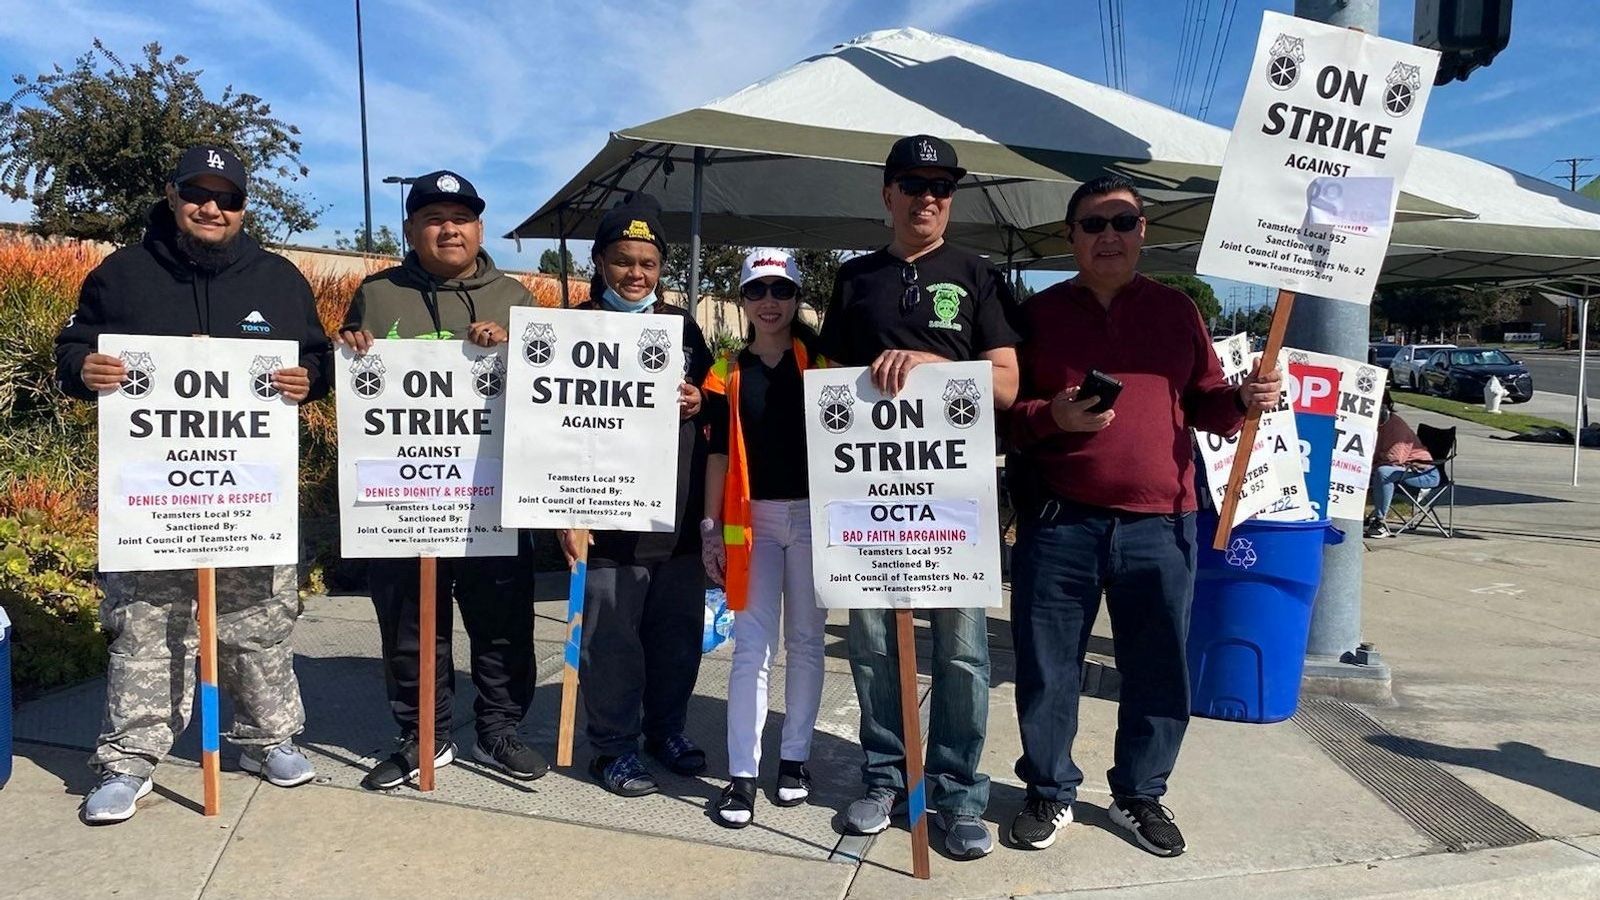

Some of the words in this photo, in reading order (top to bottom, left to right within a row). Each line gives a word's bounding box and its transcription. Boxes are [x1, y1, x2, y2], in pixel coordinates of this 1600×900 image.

[1316, 65, 1368, 106] ON
[1261, 102, 1393, 159] STRIKE
[206, 150, 225, 170] LA
[1285, 154, 1350, 178] AGAINST
[1257, 219, 1301, 234] Teamsters
[1303, 228, 1326, 241] Local
[1328, 232, 1346, 244] 952
[1265, 235, 1313, 252] Sanctioned
[1316, 246, 1330, 256] By:
[1220, 240, 1242, 252] Joint
[1244, 245, 1278, 259] Council
[1281, 252, 1291, 262] of
[1293, 253, 1335, 271] Teamsters
[1337, 261, 1352, 272] No.
[1354, 265, 1365, 276] 42
[1248, 259, 1333, 282] www.Teamsters952.org
[241, 324, 271, 333] TOKYO
[572, 341, 619, 369] ON
[174, 370, 229, 399] ON
[403, 370, 452, 398] ON
[532, 377, 655, 408] STRIKE
[872, 399, 924, 430] ON
[130, 409, 270, 438] STRIKE
[365, 408, 492, 435] STRIKE
[562, 416, 624, 429] AGAINST
[166, 450, 237, 462] AGAINST
[397, 446, 461, 458] AGAINST
[835, 439, 967, 473] STRIKE
[399, 464, 461, 480] OCTA
[1332, 459, 1362, 473] GAINING
[168, 470, 236, 486] OCTA
[548, 474, 590, 482] Teamsters
[366, 488, 399, 497] DENIES
[404, 487, 441, 497] DIGNITY
[444, 488, 450, 496] &
[455, 487, 494, 497] RESPECT
[560, 485, 606, 494] Sanctioned
[609, 487, 622, 495] By:
[868, 483, 934, 496] AGAINST
[129, 495, 168, 506] DENIES
[172, 495, 214, 505] DIGNITY
[218, 495, 225, 504] &
[229, 493, 272, 503] RESPECT
[518, 496, 539, 504] Joint
[589, 498, 630, 506] Teamsters
[153, 511, 200, 519] Teamsters
[450, 515, 463, 523] By:
[549, 508, 631, 517] www.Teamsters952.org
[870, 505, 936, 522] OCTA
[166, 523, 220, 531] Sanctioned
[224, 523, 237, 532] By:
[357, 526, 378, 534] Joint
[381, 526, 413, 534] Council
[417, 526, 425, 534] of
[118, 537, 142, 545] Joint
[146, 536, 182, 544] Council
[187, 535, 196, 543] of
[200, 535, 247, 543] Teamsters
[389, 536, 473, 544] www.Teamsters952.org
[843, 531, 862, 541] BAD
[867, 531, 895, 541] FAITH
[899, 530, 966, 541] BARGAINING
[154, 546, 249, 555] www.Teamsters952.org
[907, 547, 930, 555] Local
[872, 560, 921, 569] Sanctioned
[925, 560, 939, 569] By:
[830, 574, 851, 583] Joint
[855, 573, 887, 581] Council
[891, 573, 900, 581] of
[904, 572, 949, 581] Teamsters
[953, 572, 968, 580] No.
[862, 585, 952, 593] www.Teamsters952.org
